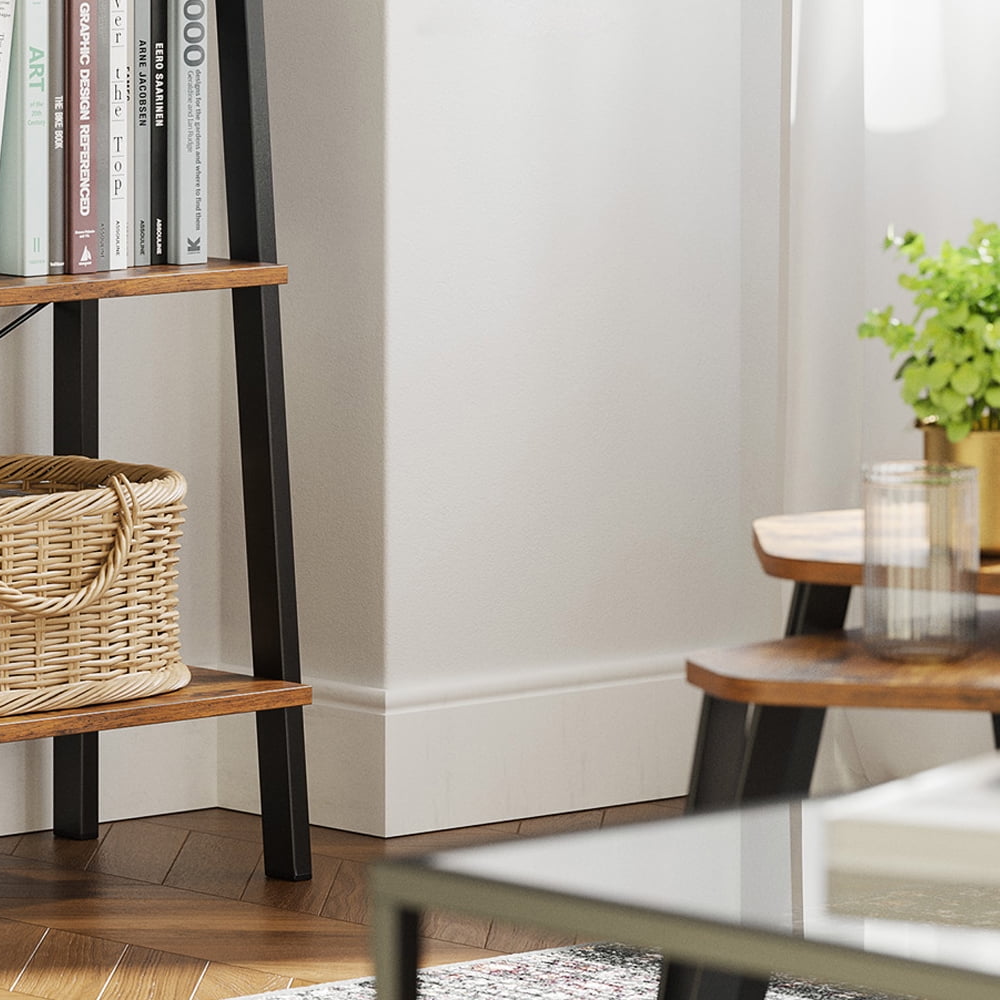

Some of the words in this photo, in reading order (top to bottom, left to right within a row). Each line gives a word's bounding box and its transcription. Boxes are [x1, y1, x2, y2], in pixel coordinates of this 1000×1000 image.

[79, 2, 91, 66] GRAPHIC
[138, 40, 147, 68] ARNE
[155, 42, 164, 70] EERO
[29, 46, 45, 92] ART
[54, 96, 64, 110] THE
[79, 69, 91, 120] DESIGN
[114, 68, 122, 117] the
[138, 72, 147, 127] JACOBSEN
[155, 73, 164, 127] SAARINEN
[54, 111, 64, 128] BIKE
[54, 130, 64, 150] BOOK
[194, 121, 202, 150] gardens
[79, 124, 91, 217] REFERENCED
[113, 136, 123, 196] Top
[195, 188, 201, 197] to
